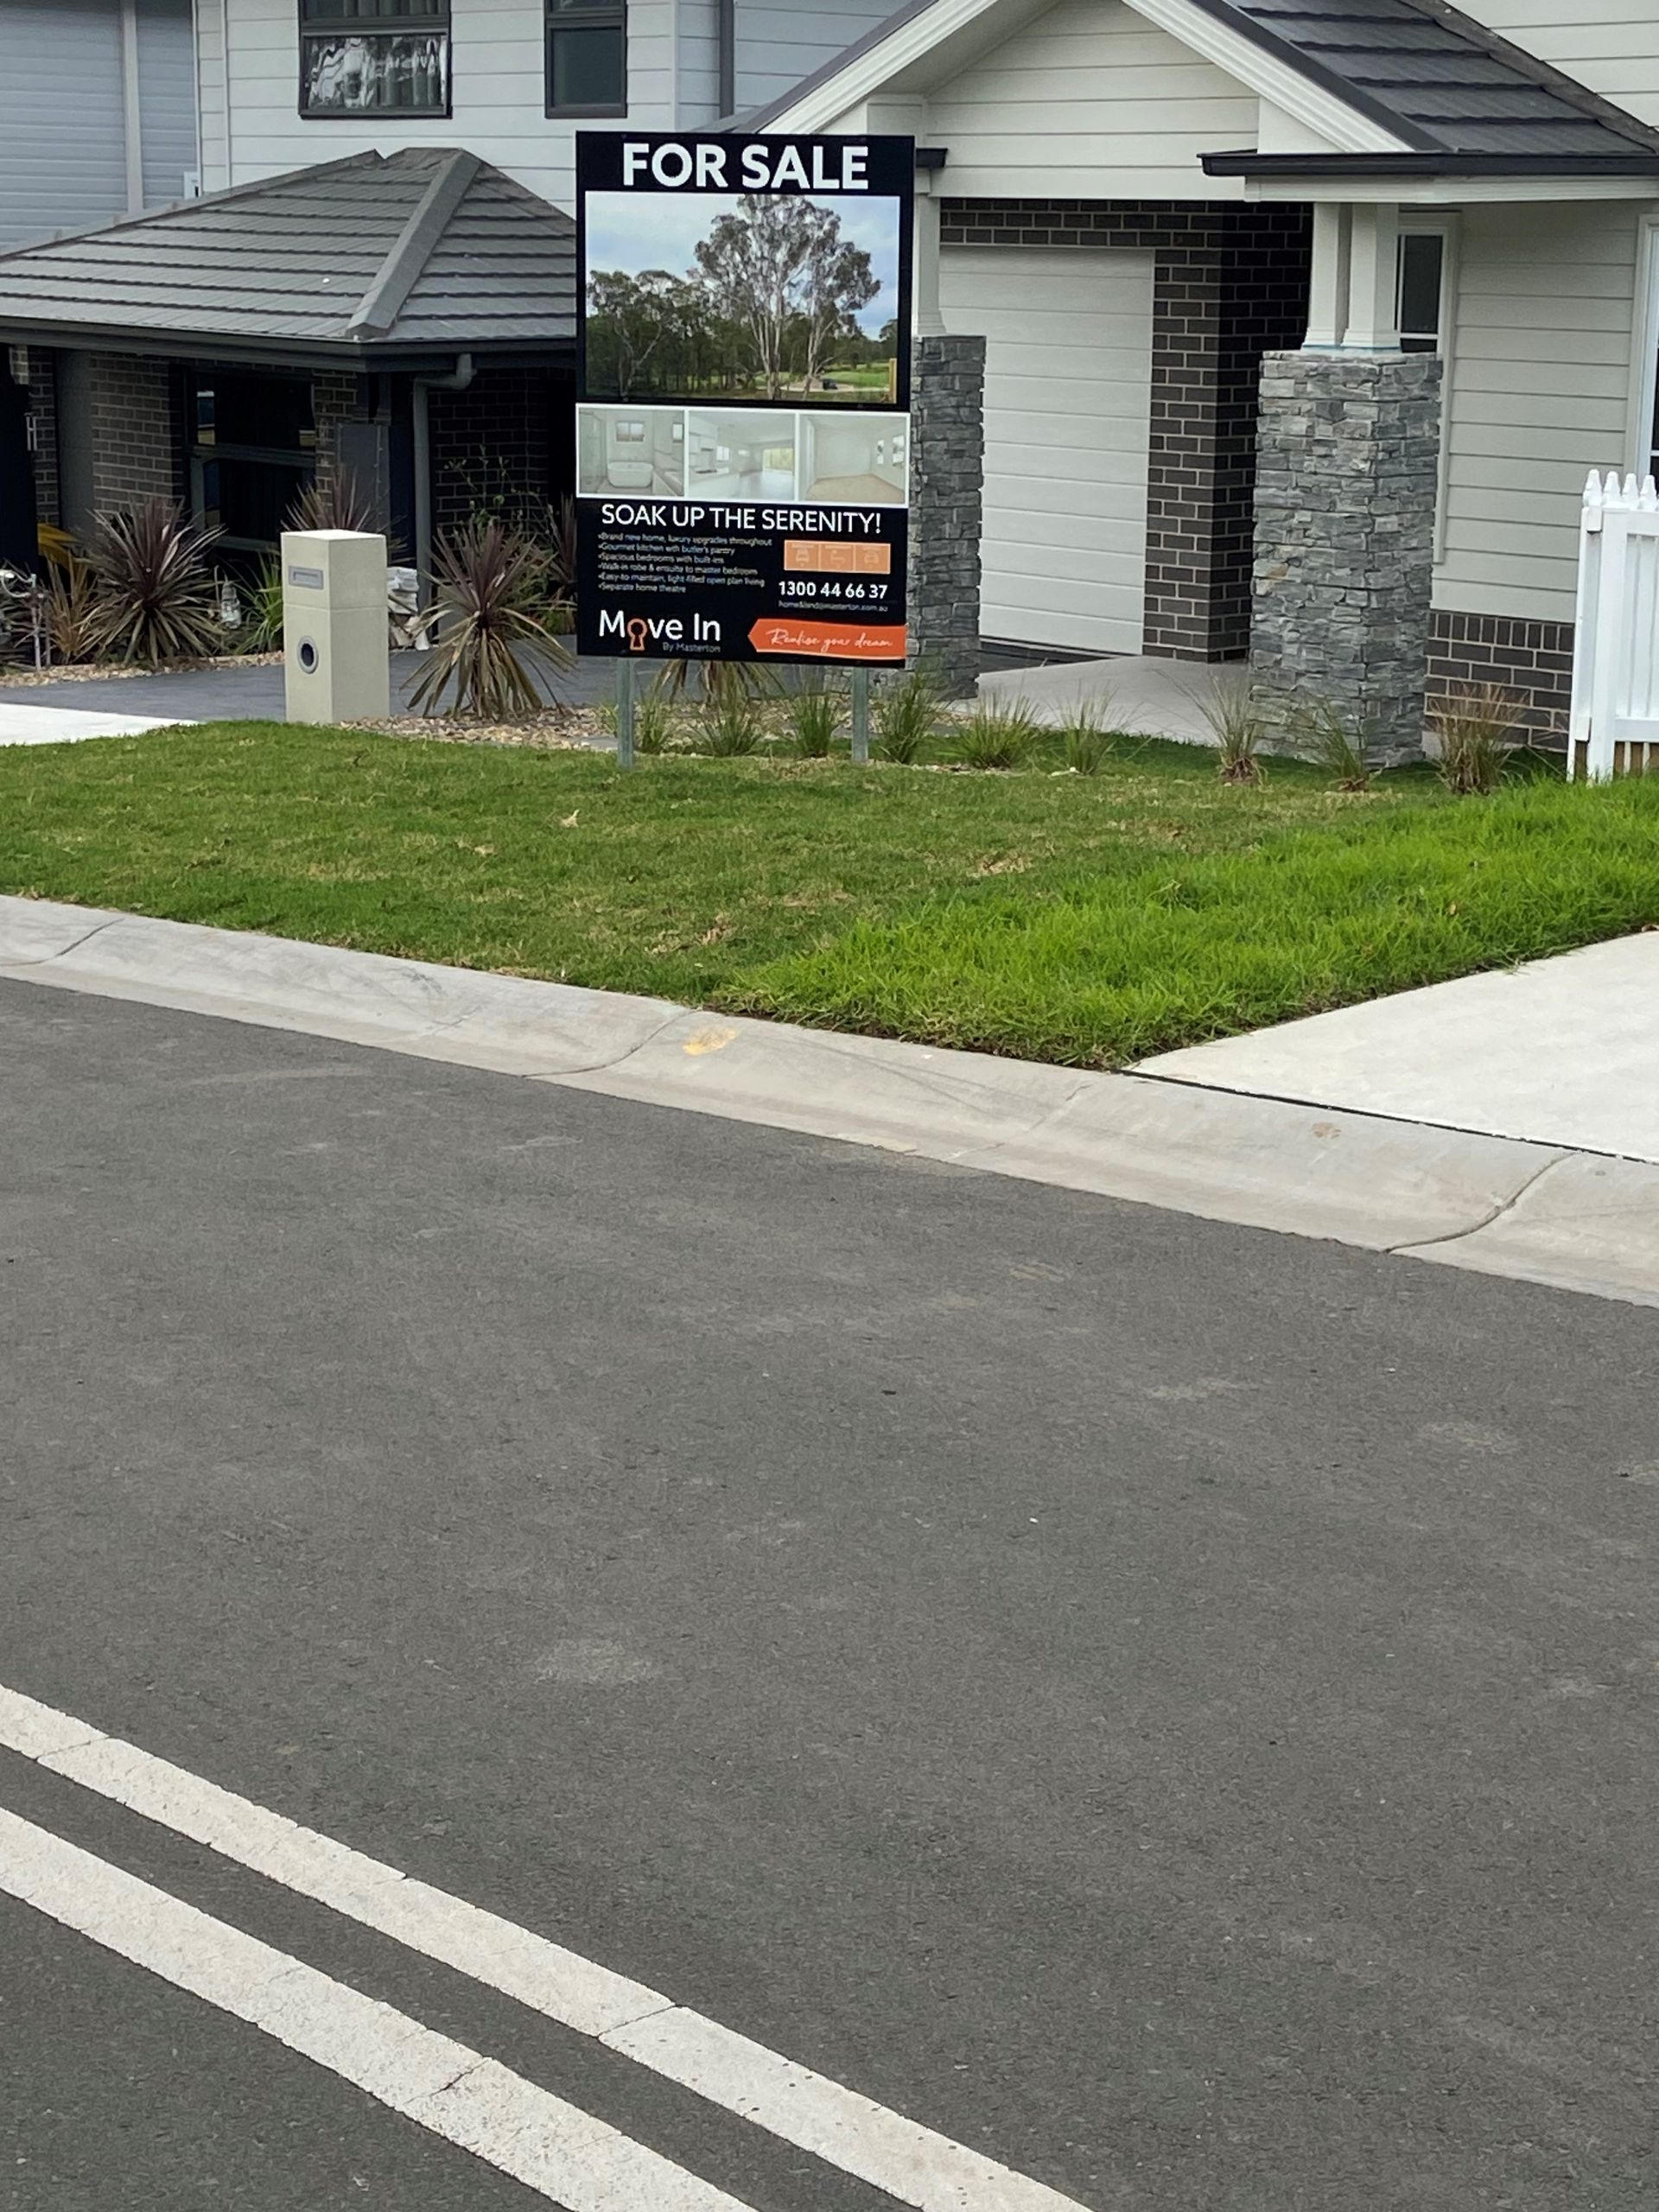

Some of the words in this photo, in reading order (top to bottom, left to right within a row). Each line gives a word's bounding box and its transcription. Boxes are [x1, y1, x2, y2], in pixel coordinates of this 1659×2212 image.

[623, 143, 728, 188] FOR
[741, 143, 868, 189] SALE
[601, 504, 666, 525] SOAK
[672, 507, 705, 527] UP
[709, 508, 756, 530] THE
[761, 511, 881, 534] SERENITY!
[601, 531, 624, 542] Brand
[668, 534, 690, 544] luxury
[692, 537, 728, 546] upgrades
[729, 537, 772, 548] throughout
[601, 542, 635, 551] Gourmet
[636, 543, 664, 551] kitchen
[710, 547, 735, 556] pantry
[601, 551, 635, 562] Spacious
[636, 553, 675, 563] bedrooms
[676, 555, 692, 563] with
[649, 563, 654, 572] &
[656, 564, 683, 573] ensuite
[685, 565, 693, 574] to
[722, 566, 758, 575] bedroom
[601, 582, 634, 591] Separate
[636, 582, 658, 592] home
[659, 584, 686, 593] theatre
[727, 576, 743, 586] plan
[744, 576, 765, 588] living
[779, 581, 817, 596] 1300
[820, 582, 842, 597] 44
[845, 582, 865, 598] 66
[868, 583, 888, 599] 37
[599, 609, 683, 651] Move
[694, 613, 721, 641] In
[663, 642, 674, 652] By
[676, 643, 721, 653] Masterton
[766, 628, 821, 645] Realise
[823, 638, 851, 652] your
[854, 632, 893, 649] dream
